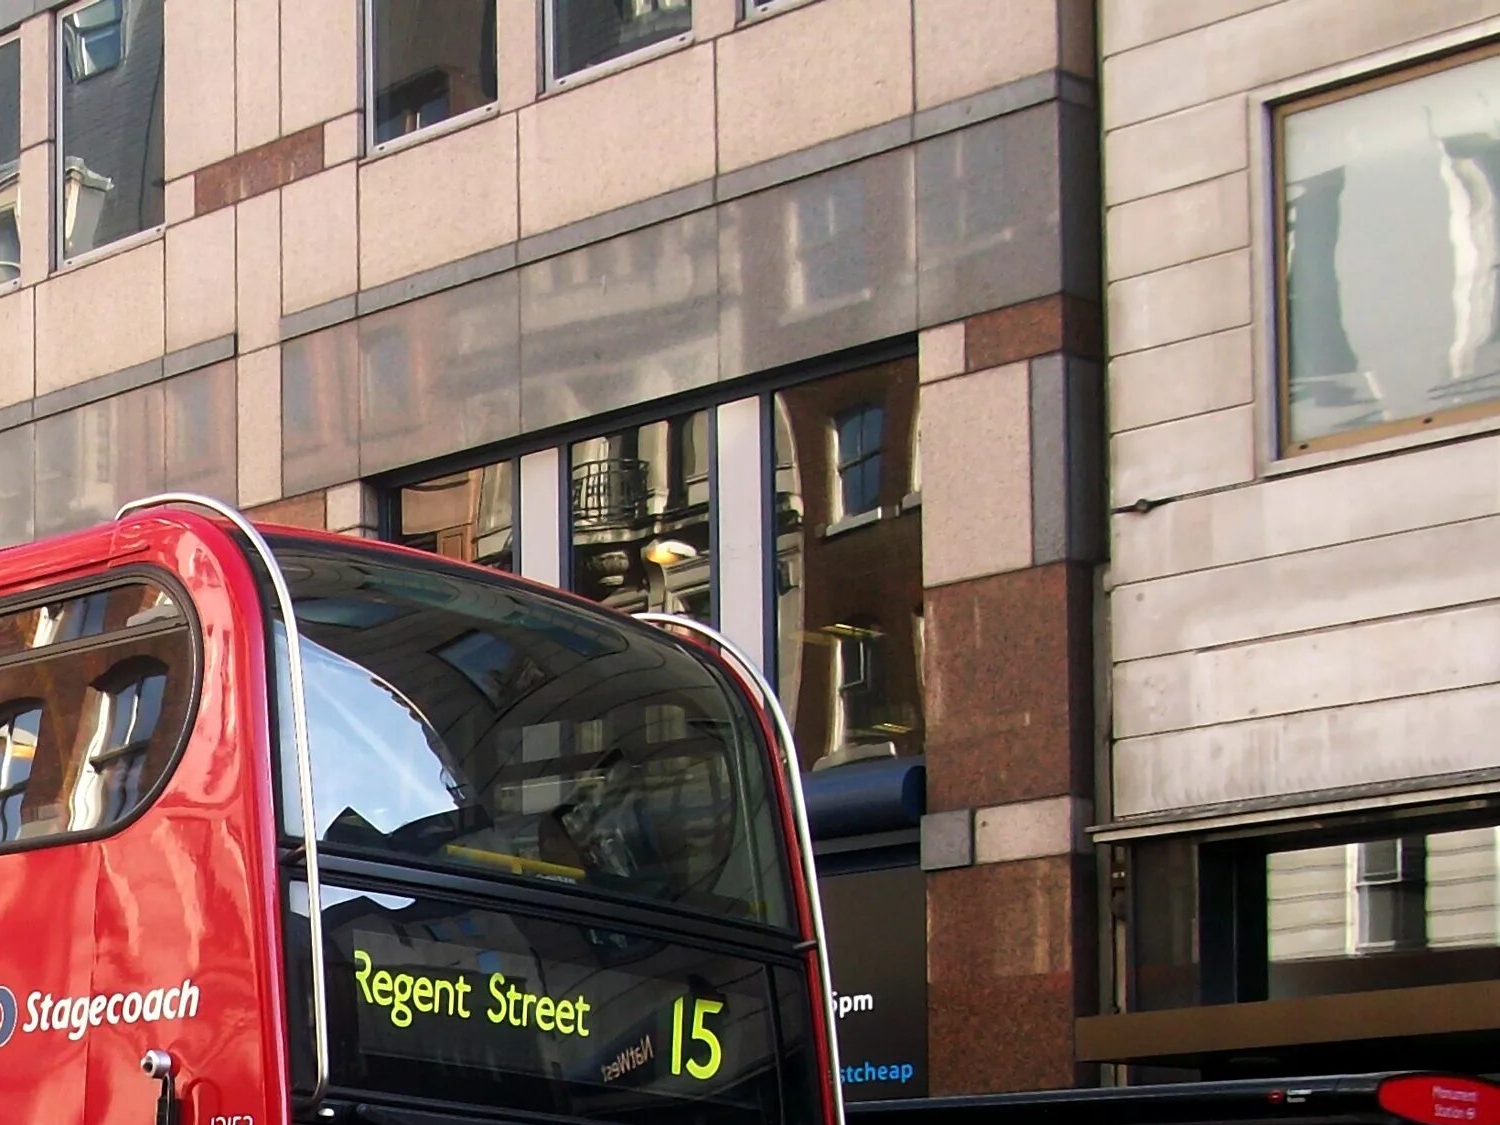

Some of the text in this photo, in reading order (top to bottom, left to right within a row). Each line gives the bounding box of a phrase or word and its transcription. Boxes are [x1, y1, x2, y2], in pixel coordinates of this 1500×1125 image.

[21, 978, 200, 1041] Stagecoach
[354, 949, 592, 1037] Regent Street
[670, 996, 724, 1080] 15
